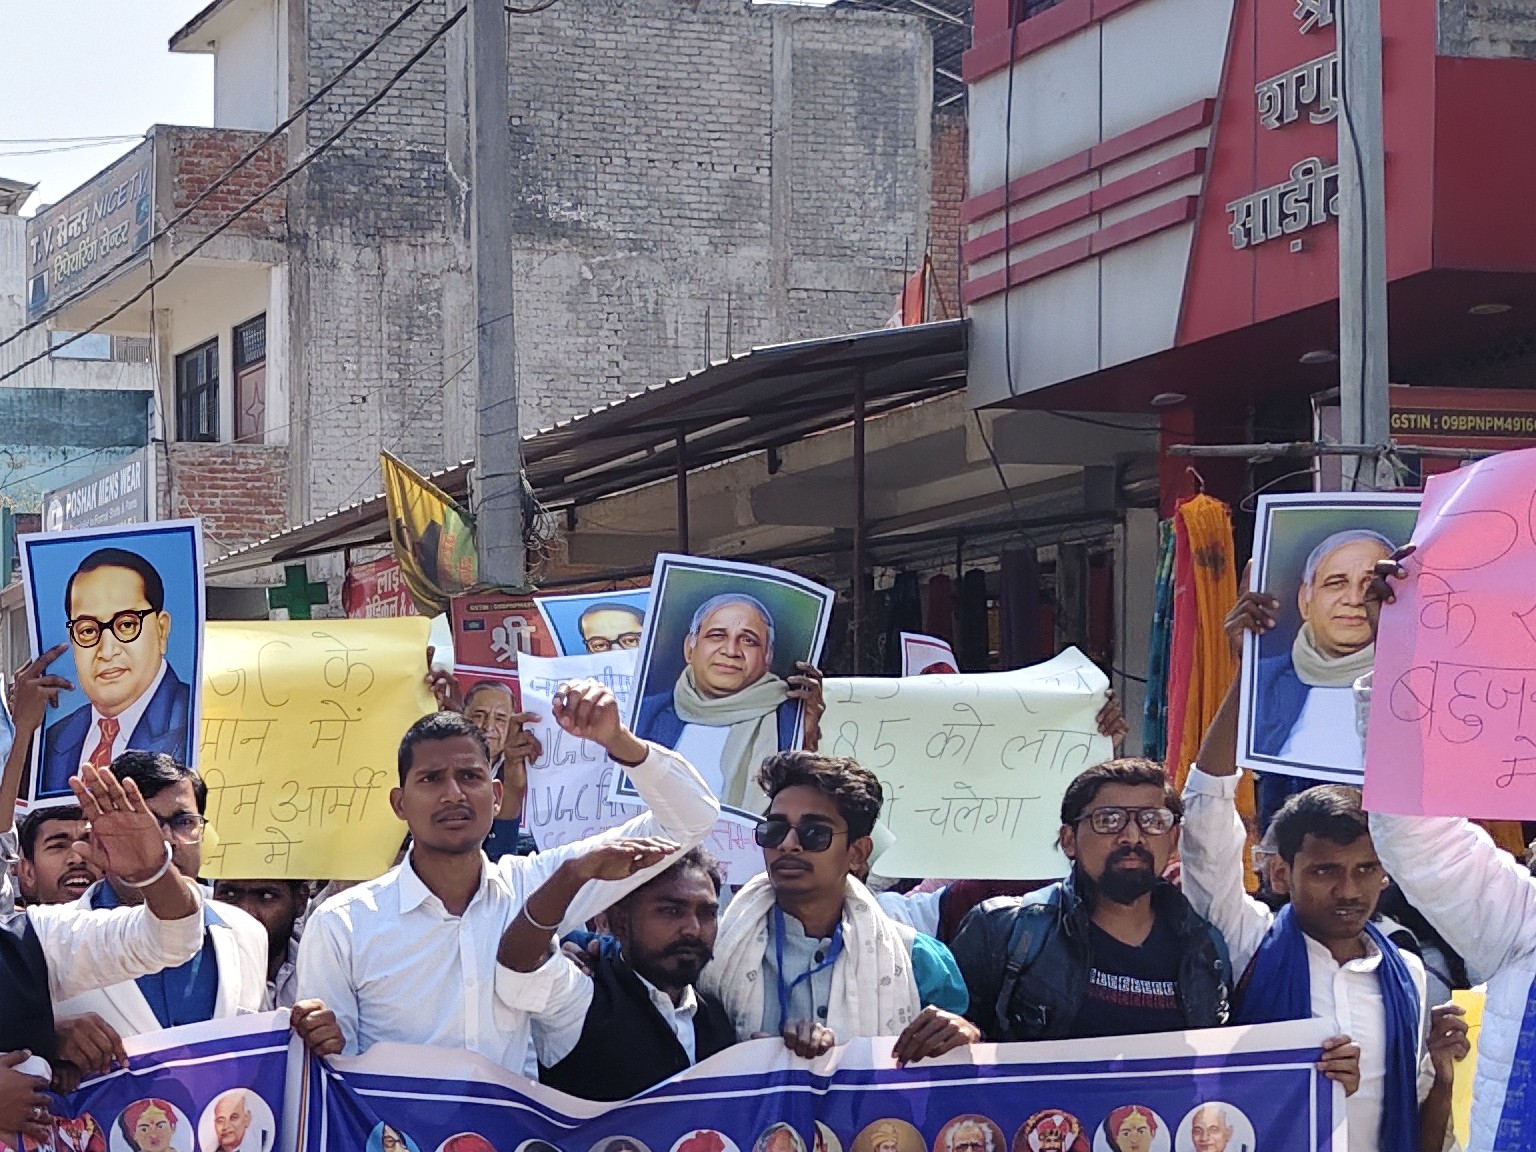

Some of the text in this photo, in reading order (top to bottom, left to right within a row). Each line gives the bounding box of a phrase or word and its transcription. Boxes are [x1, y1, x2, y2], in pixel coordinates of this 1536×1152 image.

[1254, 50, 1339, 130] शगु
[92, 181, 128, 224] NICE
[1226, 156, 1340, 252] साड़ी
[1391, 413, 1431, 429] GSTIN
[1442, 415, 1536, 432] 09BPNPM4916
[66, 482, 97, 519] POSHAK
[98, 472, 119, 507] MENS
[120, 462, 141, 496] WEAR
[312, 631, 375, 697] के
[490, 615, 536, 663] श्री
[310, 700, 363, 766] में
[926, 703, 995, 766] को
[532, 783, 589, 827] UGC
[915, 782, 1041, 839] चलेगा
